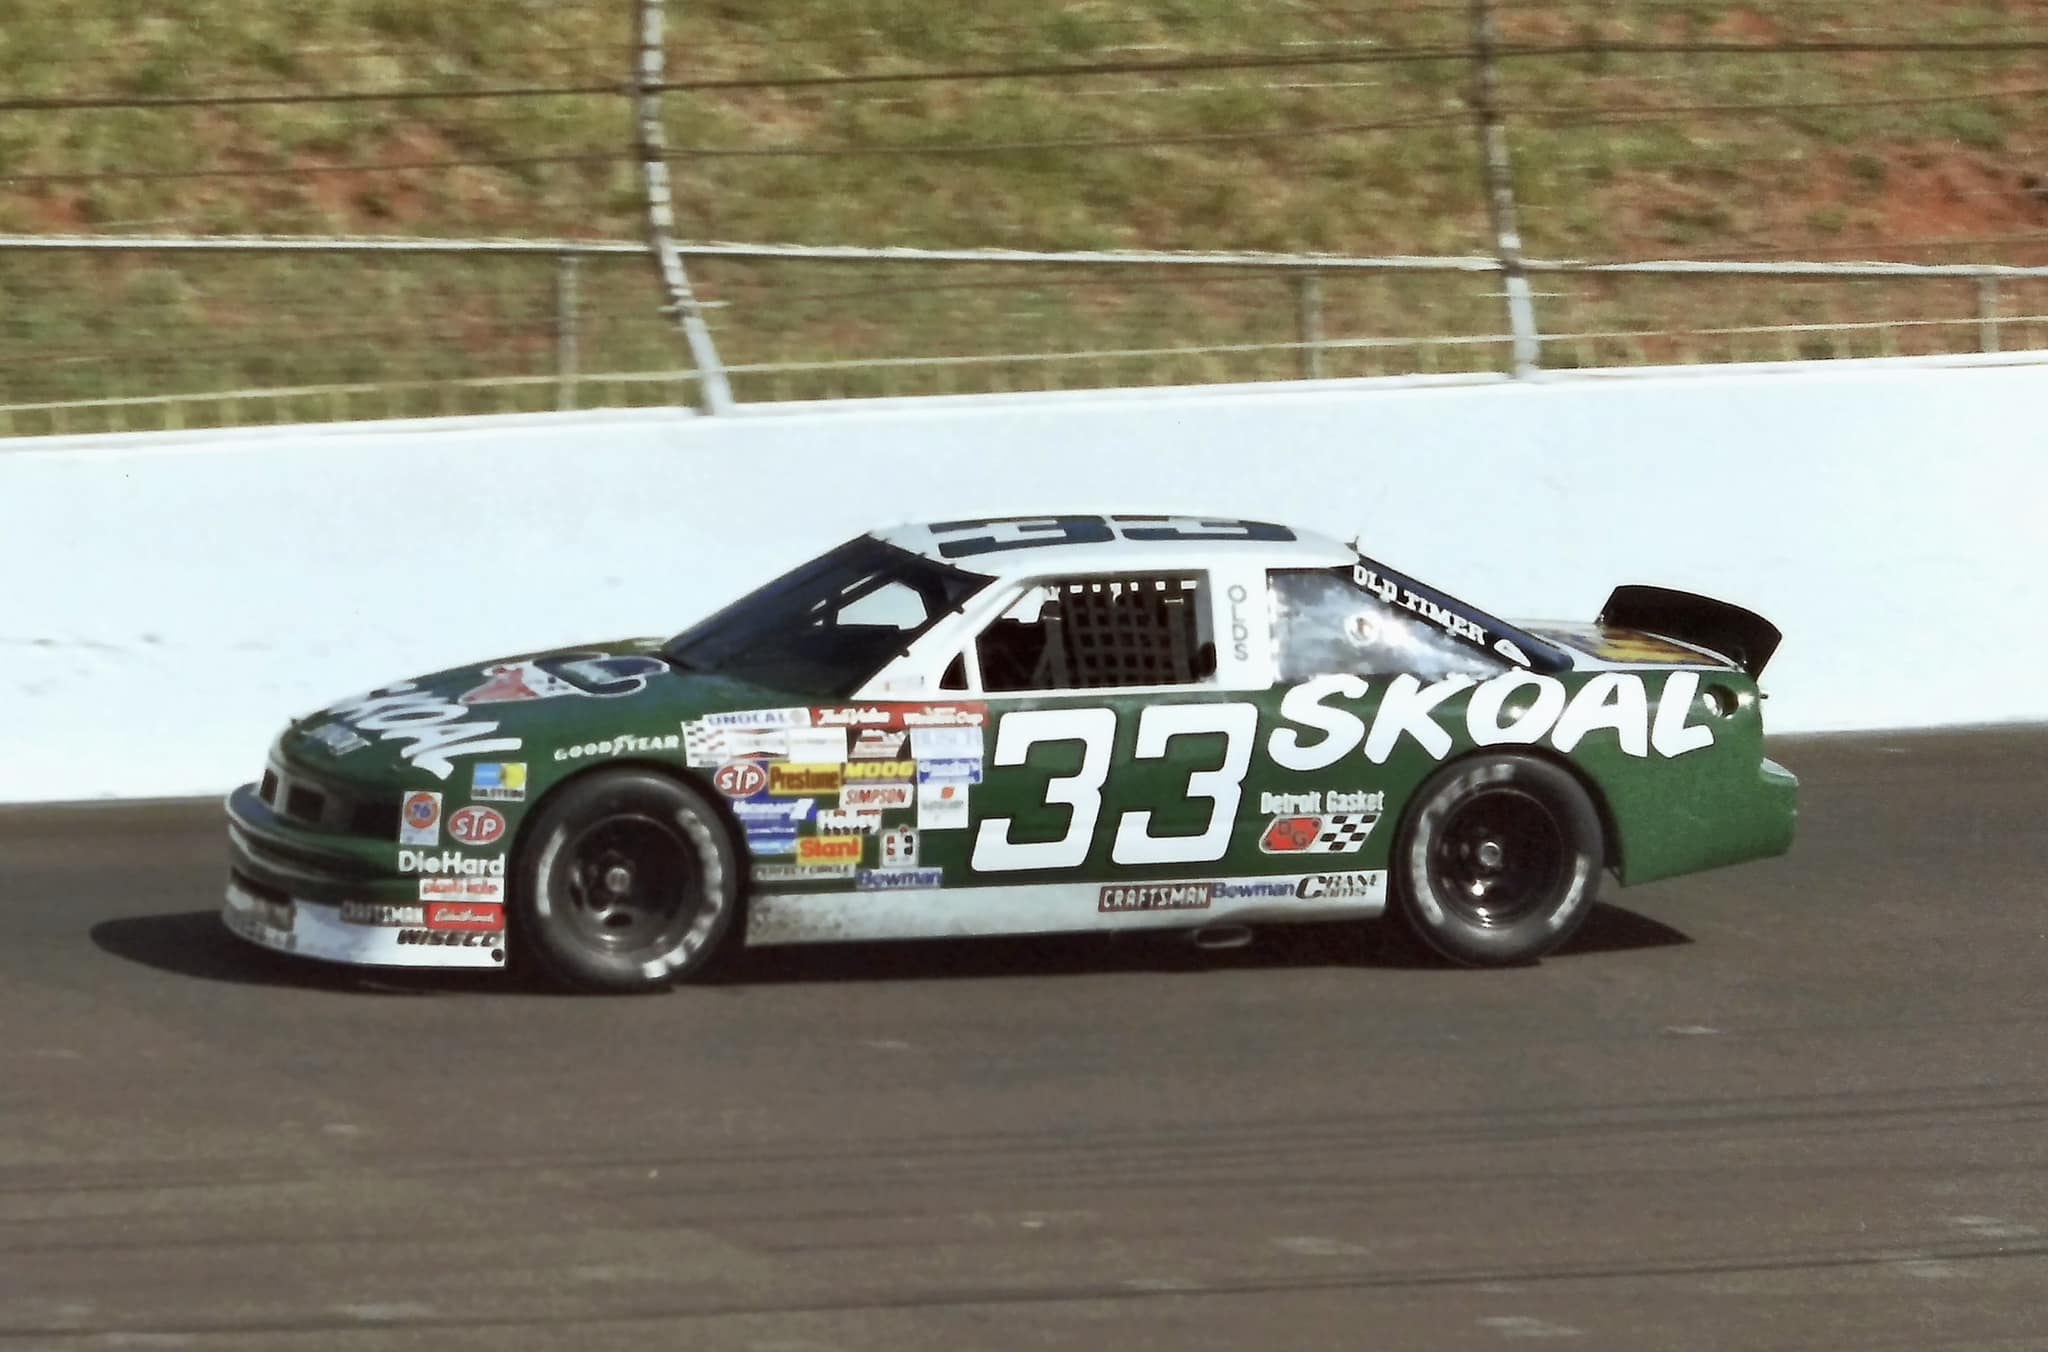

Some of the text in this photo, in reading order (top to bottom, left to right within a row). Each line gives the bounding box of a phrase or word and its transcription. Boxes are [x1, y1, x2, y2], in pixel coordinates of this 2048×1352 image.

[1227, 584, 1250, 662] OLDS
[1403, 589, 1488, 646] TIMER
[707, 711, 785, 727] UNOCAL
[1267, 668, 1715, 771] SKOAL
[553, 733, 680, 761] GOODYEAR
[721, 764, 759, 790] STP
[769, 767, 840, 791] Prestone
[843, 760, 915, 780] MOOG
[846, 787, 907, 805] SIMPSON
[971, 702, 1259, 872] 33
[1260, 790, 1385, 814] Detroit Gasket
[456, 810, 498, 838] STP
[398, 850, 505, 875] DieHard
[857, 870, 942, 889] Bowman
[1213, 882, 1295, 899] Bowman
[1103, 886, 1209, 909] CRAFTSMAN
